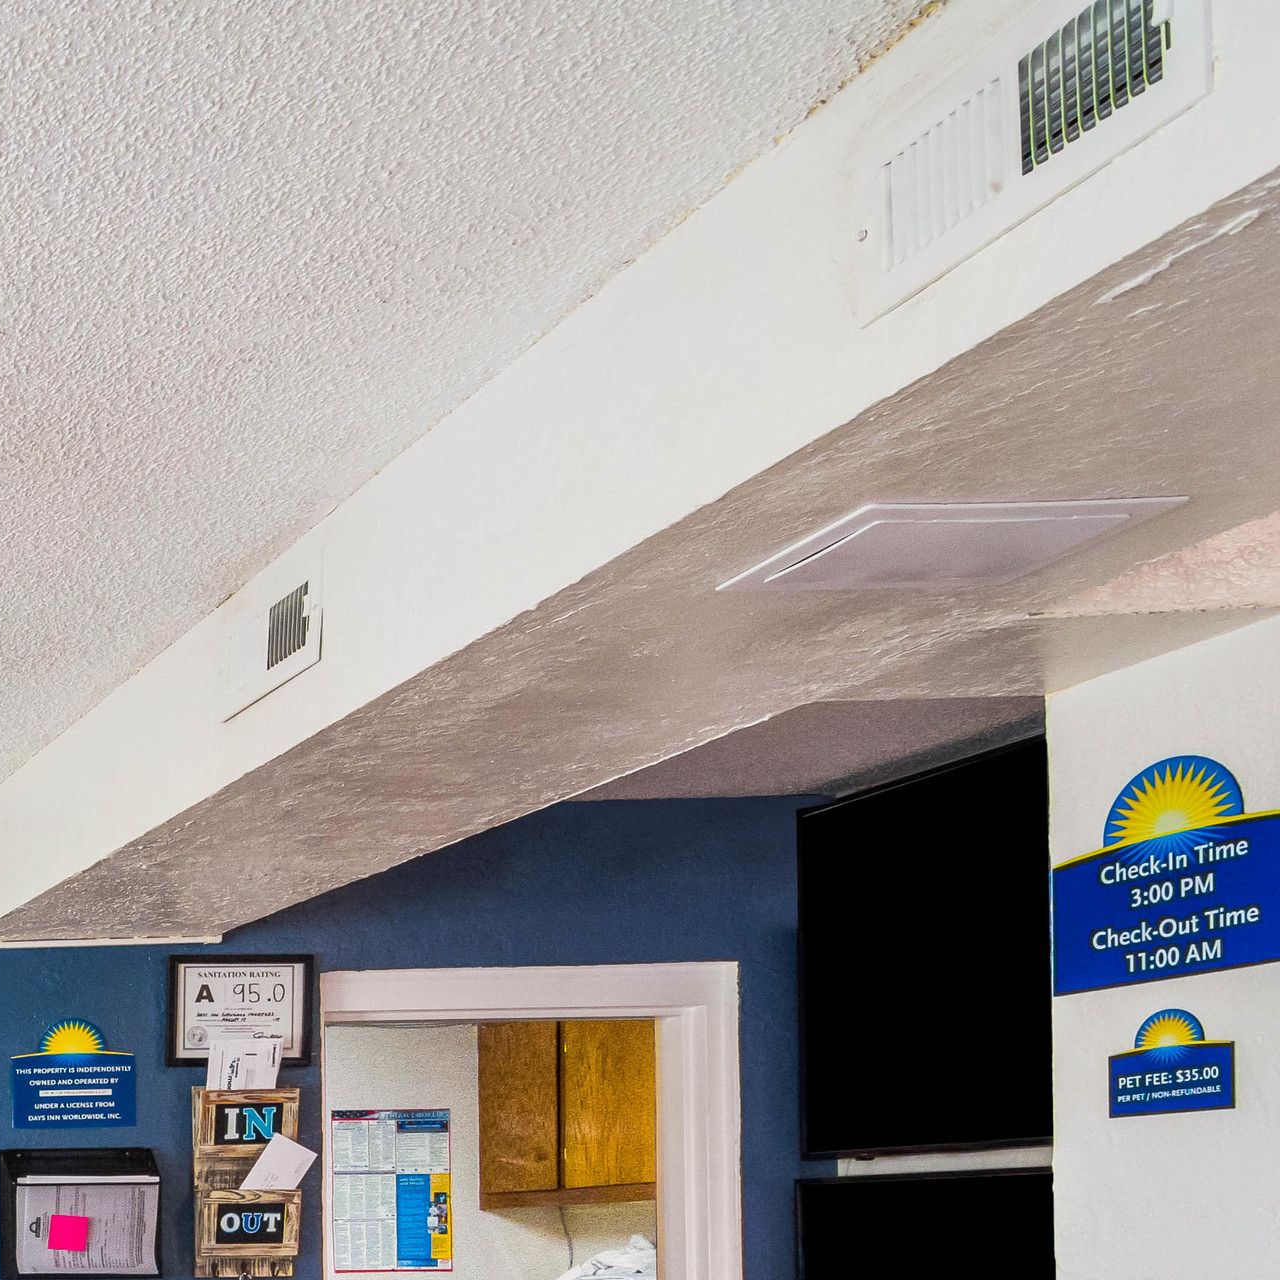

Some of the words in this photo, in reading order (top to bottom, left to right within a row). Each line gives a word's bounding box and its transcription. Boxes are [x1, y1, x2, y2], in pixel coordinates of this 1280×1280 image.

[1100, 852, 1188, 885] Check-In
[1194, 840, 1249, 864] Time
[1130, 881, 1174, 908] 3:00
[1180, 873, 1215, 898] PM
[1092, 914, 1199, 950] Check-Out
[1204, 907, 1260, 930] Time
[1125, 946, 1180, 973] 11:00
[1185, 939, 1222, 964] AM
[197, 971, 247, 979] SANITATION
[195, 984, 215, 1003] A
[233, 983, 286, 1003] 95.0
[76, 1065, 132, 1073] INDEPENDENTLY
[1118, 1075, 1142, 1090] PET
[1145, 1072, 1173, 1086] FEE:
[1175, 1066, 1219, 1083] $35.00
[1117, 1093, 1131, 1103] PER
[1132, 1093, 1146, 1101] PET
[1151, 1085, 1222, 1099] NON-REFUNDABLE
[223, 1106, 277, 1141] IN
[219, 1212, 281, 1234] OUT
